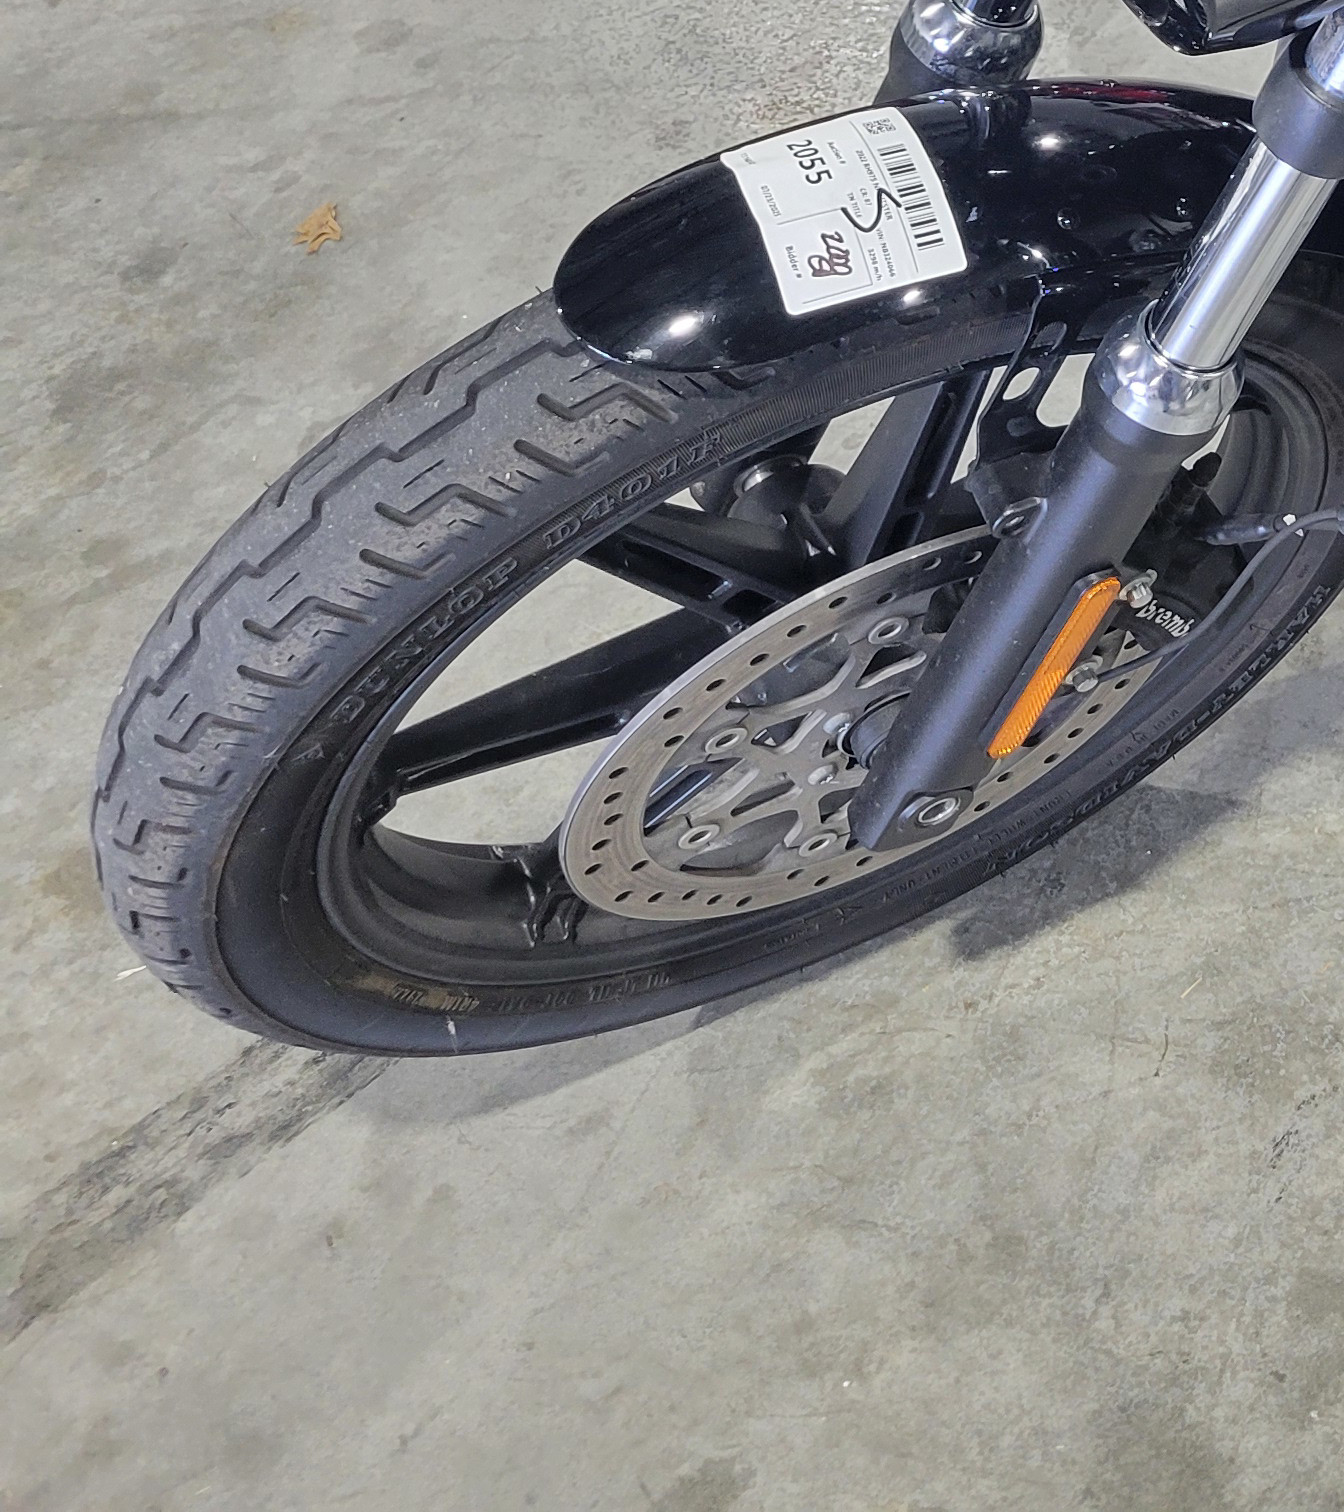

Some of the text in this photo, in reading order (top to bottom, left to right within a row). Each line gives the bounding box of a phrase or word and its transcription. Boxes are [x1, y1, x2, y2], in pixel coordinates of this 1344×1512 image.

[786, 138, 834, 186] 2055
[784, 245, 801, 272] Bidder
[334, 553, 521, 726] DUNLOP
[1140, 597, 1196, 639] bremb
